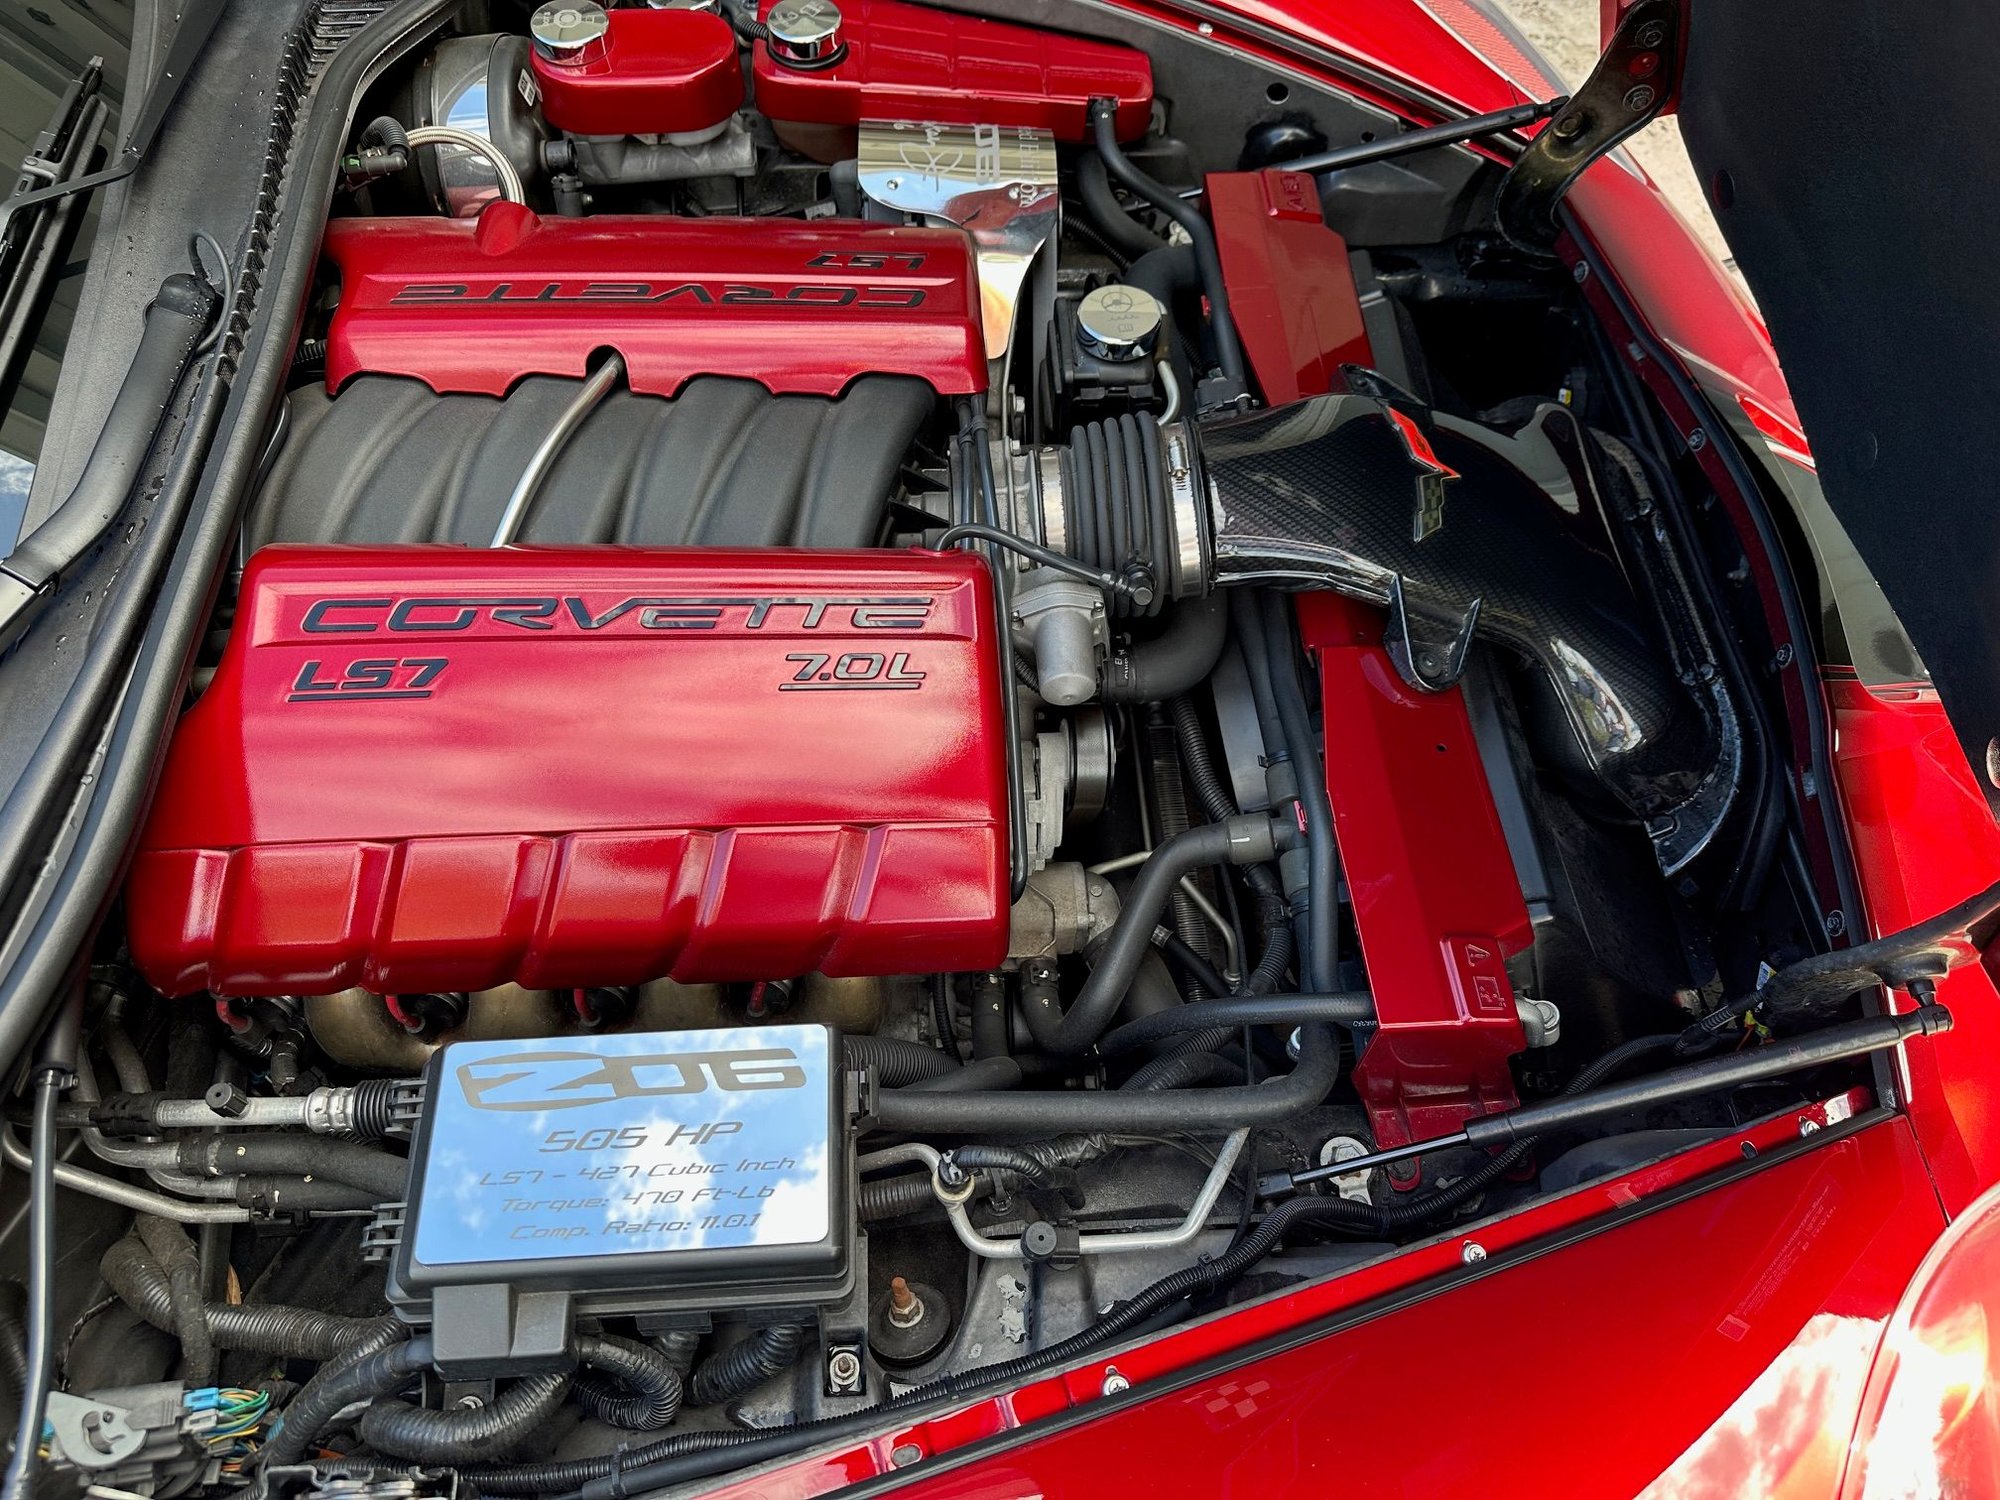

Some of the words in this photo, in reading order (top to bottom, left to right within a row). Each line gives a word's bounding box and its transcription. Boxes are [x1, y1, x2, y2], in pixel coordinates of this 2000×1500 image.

[805, 253, 927, 270] LS7
[390, 283, 927, 307] CORVETTE
[302, 597, 935, 632] CORVETTE
[294, 658, 449, 690] LS7
[786, 653, 926, 681] 7.0L
[455, 1047, 807, 1112] Z06
[539, 1127, 648, 1152] 505
[665, 1121, 743, 1146] HP
[480, 1170, 544, 1186] LS7
[579, 1165, 640, 1181] 427
[648, 1163, 725, 1178] Cubic
[735, 1157, 796, 1172] Inch
[501, 1198, 608, 1213] Torque:
[622, 1189, 683, 1204] 470
[691, 1185, 775, 1202] Ft-Lb
[509, 1225, 590, 1241] Comp.
[602, 1219, 692, 1235] Ratio:
